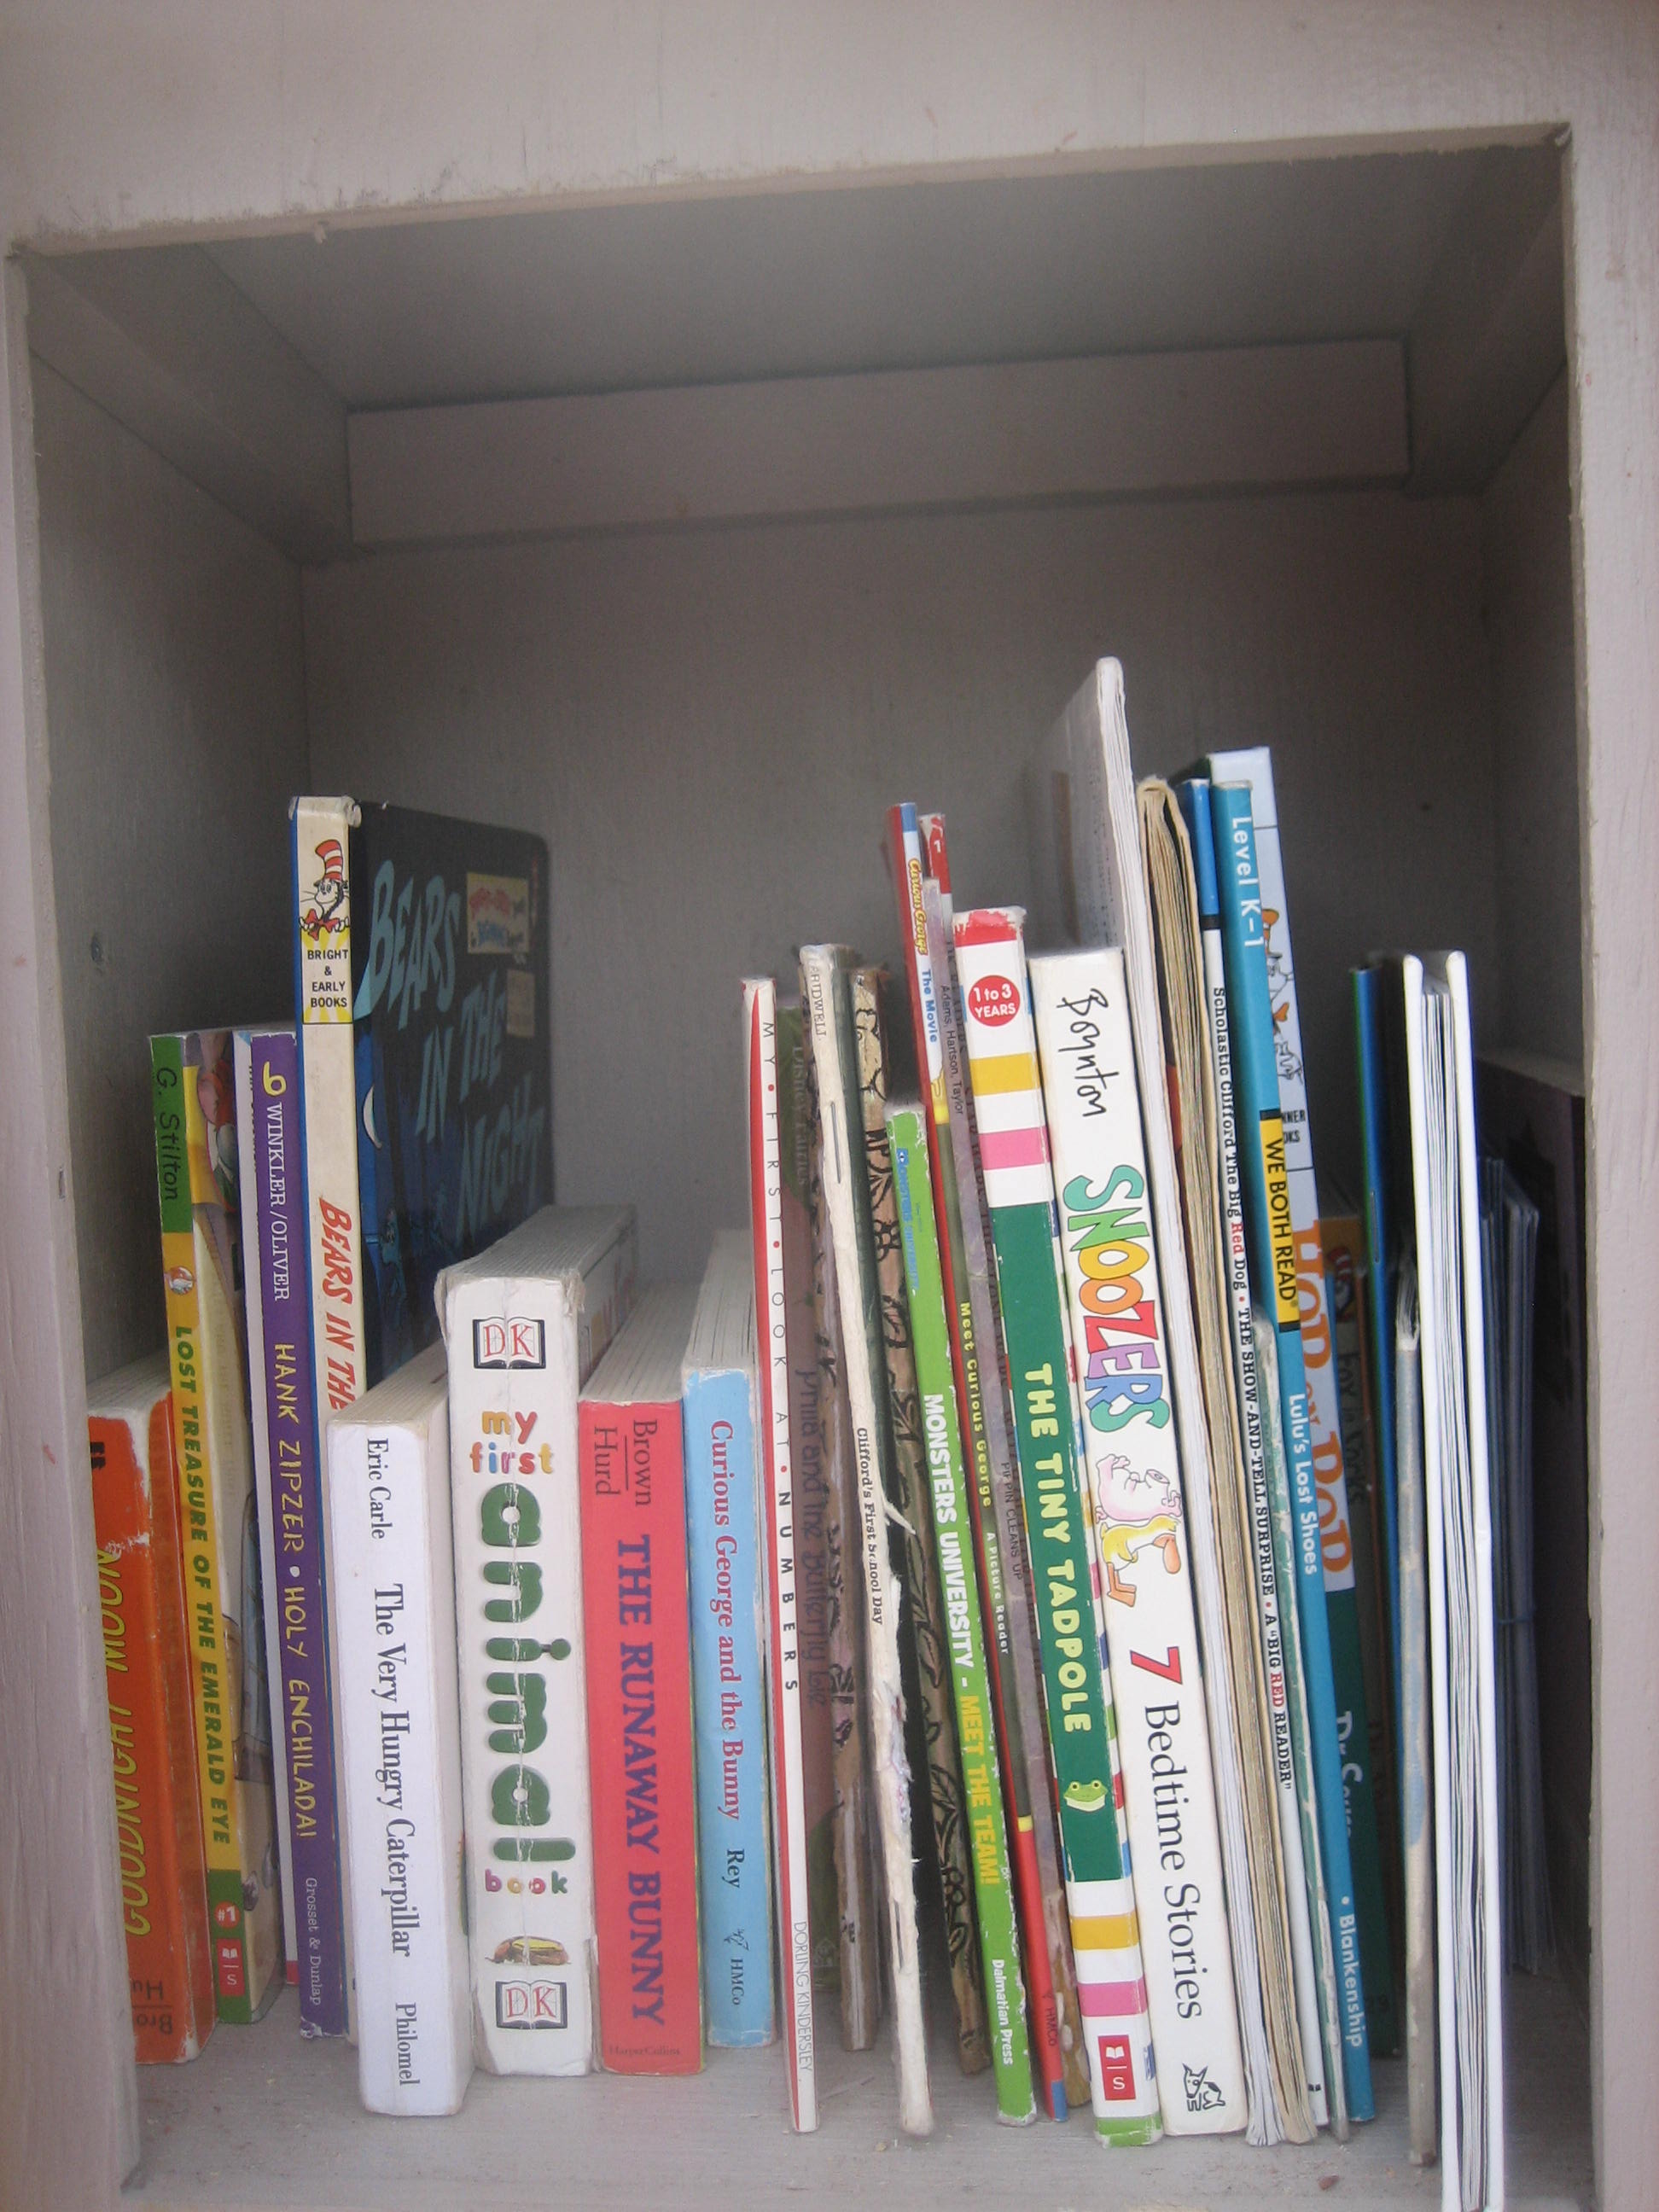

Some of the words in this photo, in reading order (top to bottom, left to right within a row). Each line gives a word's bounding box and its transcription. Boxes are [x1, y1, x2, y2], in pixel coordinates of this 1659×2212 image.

[1232, 816, 1259, 885] Level
[908, 859, 924, 908] Curious
[352, 859, 461, 1031] BEARS
[912, 910, 928, 956] George
[1241, 901, 1266, 948] K-1
[306, 948, 349, 961] BRIGHT
[324, 966, 333, 977] &
[310, 996, 348, 1009] BOOKS
[311, 981, 346, 994] EARLY
[920, 969, 932, 996] The
[940, 985, 952, 1027] Adams,
[973, 987, 981, 1002] 1
[984, 987, 998, 1001] to
[1000, 983, 1012, 998] 3
[459, 969, 507, 1104] THE
[925, 999, 939, 1043] Movie
[975, 1004, 1016, 1018] YEARS
[1213, 987, 1232, 1075] Scholastic
[763, 1022, 776, 1066] MY
[946, 1031, 959, 1079] Hartson,
[1057, 988, 1120, 1117] Boynton
[156, 1067, 178, 1097] G.
[262, 1062, 287, 1097] 6
[415, 1025, 454, 1144] IN
[952, 1080, 964, 1115] Taylor
[1220, 1080, 1236, 1148] Clifford
[160, 1114, 180, 1201] Stilton
[266, 1102, 287, 1207] WINKLER
[456, 1071, 546, 1247] NIGHT
[765, 1113, 782, 1220] FIRST
[1225, 1152, 1239, 1187] The
[1266, 1138, 1286, 1173] WE
[1227, 1190, 1242, 1219] Big
[1270, 1178, 1292, 1241] BOTH
[319, 1196, 353, 1304] BEARS
[1231, 1222, 1244, 1254] Red
[1063, 1165, 1170, 1432] SNOOZERS
[1233, 1257, 1248, 1290] Dog
[1276, 1244, 1298, 1301] READ
[326, 1313, 356, 1353] IN
[484, 1324, 535, 1358] DK
[771, 1268, 787, 1366] LOOK
[959, 1302, 975, 1353] Meet
[1237, 1307, 1254, 1346] THE
[176, 1326, 197, 1393] LOST
[275, 1343, 300, 1424] HANK
[328, 1357, 358, 1412] THE
[967, 1359, 985, 1435] Curious
[1025, 1362, 1060, 1438] THE
[481, 1412, 538, 1444] my
[776, 1412, 790, 1447] AT
[1243, 1351, 1266, 1505] SHOW-AND-TELL
[1289, 1394, 1310, 1453] Lulu's
[181, 1406, 208, 1542] TREASURE
[368, 1439, 389, 1481] Eric
[469, 1442, 554, 1475] first
[594, 1427, 620, 1496] Hurd
[632, 1419, 658, 1506] Brown
[710, 1420, 734, 1526] Curious
[923, 1394, 957, 1523] MONSTERS
[975, 1439, 992, 1509] George
[1295, 1460, 1314, 1499] Lost
[278, 1440, 305, 1552] ZIPZER
[370, 1484, 393, 1540] Carle
[863, 1503, 877, 1540] First
[1035, 1452, 1072, 1543] TINY
[987, 1532, 996, 1541] A
[1006, 1509, 1021, 1557] CLEANS
[1254, 1507, 1274, 1596] SURPRISE
[1301, 1511, 1318, 1575] Shoes
[193, 1555, 211, 1590] OF
[618, 1534, 651, 1625] THE
[710, 1534, 737, 1627] George
[778, 1493, 798, 1690] NUMBERS
[868, 1544, 882, 1593] School
[987, 1545, 1003, 1601] Picture
[1012, 1563, 1023, 1580] UP
[196, 1602, 215, 1650] THE
[284, 1586, 308, 1658] HOLY
[374, 1584, 405, 1636] The
[871, 1596, 885, 1626] Day
[939, 1532, 974, 1678] UNIVERSITY
[995, 1604, 1010, 1655] Reader
[1265, 1615, 1276, 1626] A
[480, 1482, 576, 1861] animal
[719, 1639, 742, 1682] and
[1047, 1559, 1092, 1733] TADPOLE
[1130, 1646, 1184, 1685] 7
[371, 1643, 406, 1703] Very
[1271, 1672, 1285, 1708] RED
[201, 1662, 225, 1785] EMERALD
[722, 1687, 743, 1731] the
[959, 1696, 984, 1756] MEET
[288, 1679, 317, 1838] ENCHILADA!
[375, 1710, 410, 1810] Hungry
[620, 1642, 661, 1854] RUNAWAY
[718, 1739, 744, 1820] Bunny
[967, 1764, 992, 1807] THE
[1144, 1701, 1188, 1871] Bedtime
[210, 1798, 230, 1844] EYE
[722, 1848, 745, 1888] Rey
[973, 1821, 1000, 1885] TEAM!
[306, 1877, 318, 1931] Grosset
[381, 1818, 421, 1957] Caterpillar
[485, 1869, 568, 1895] book
[217, 1906, 237, 1924] #1
[309, 1938, 321, 1950] &
[628, 1871, 665, 2026] BUNNY
[794, 1921, 810, 1987] DORLING
[1164, 1883, 1208, 2019] Stories
[131, 1981, 163, 2000] Hu
[227, 1974, 237, 1987] S
[309, 1955, 322, 2005] Dunlap
[507, 1987, 557, 2019] DK
[731, 1959, 744, 2005] HMCo
[992, 1959, 1010, 2026] Dalmatian
[1339, 1914, 1363, 2048] Blankenship
[137, 2015, 173, 2035] Bro
[395, 2002, 420, 2086] Philomel
[797, 1991, 813, 2071] KINDERSLEY
[1000, 2029, 1014, 2066] Press
[1045, 2007, 1058, 2046] HMCo
[1112, 2076, 1126, 2091] S
